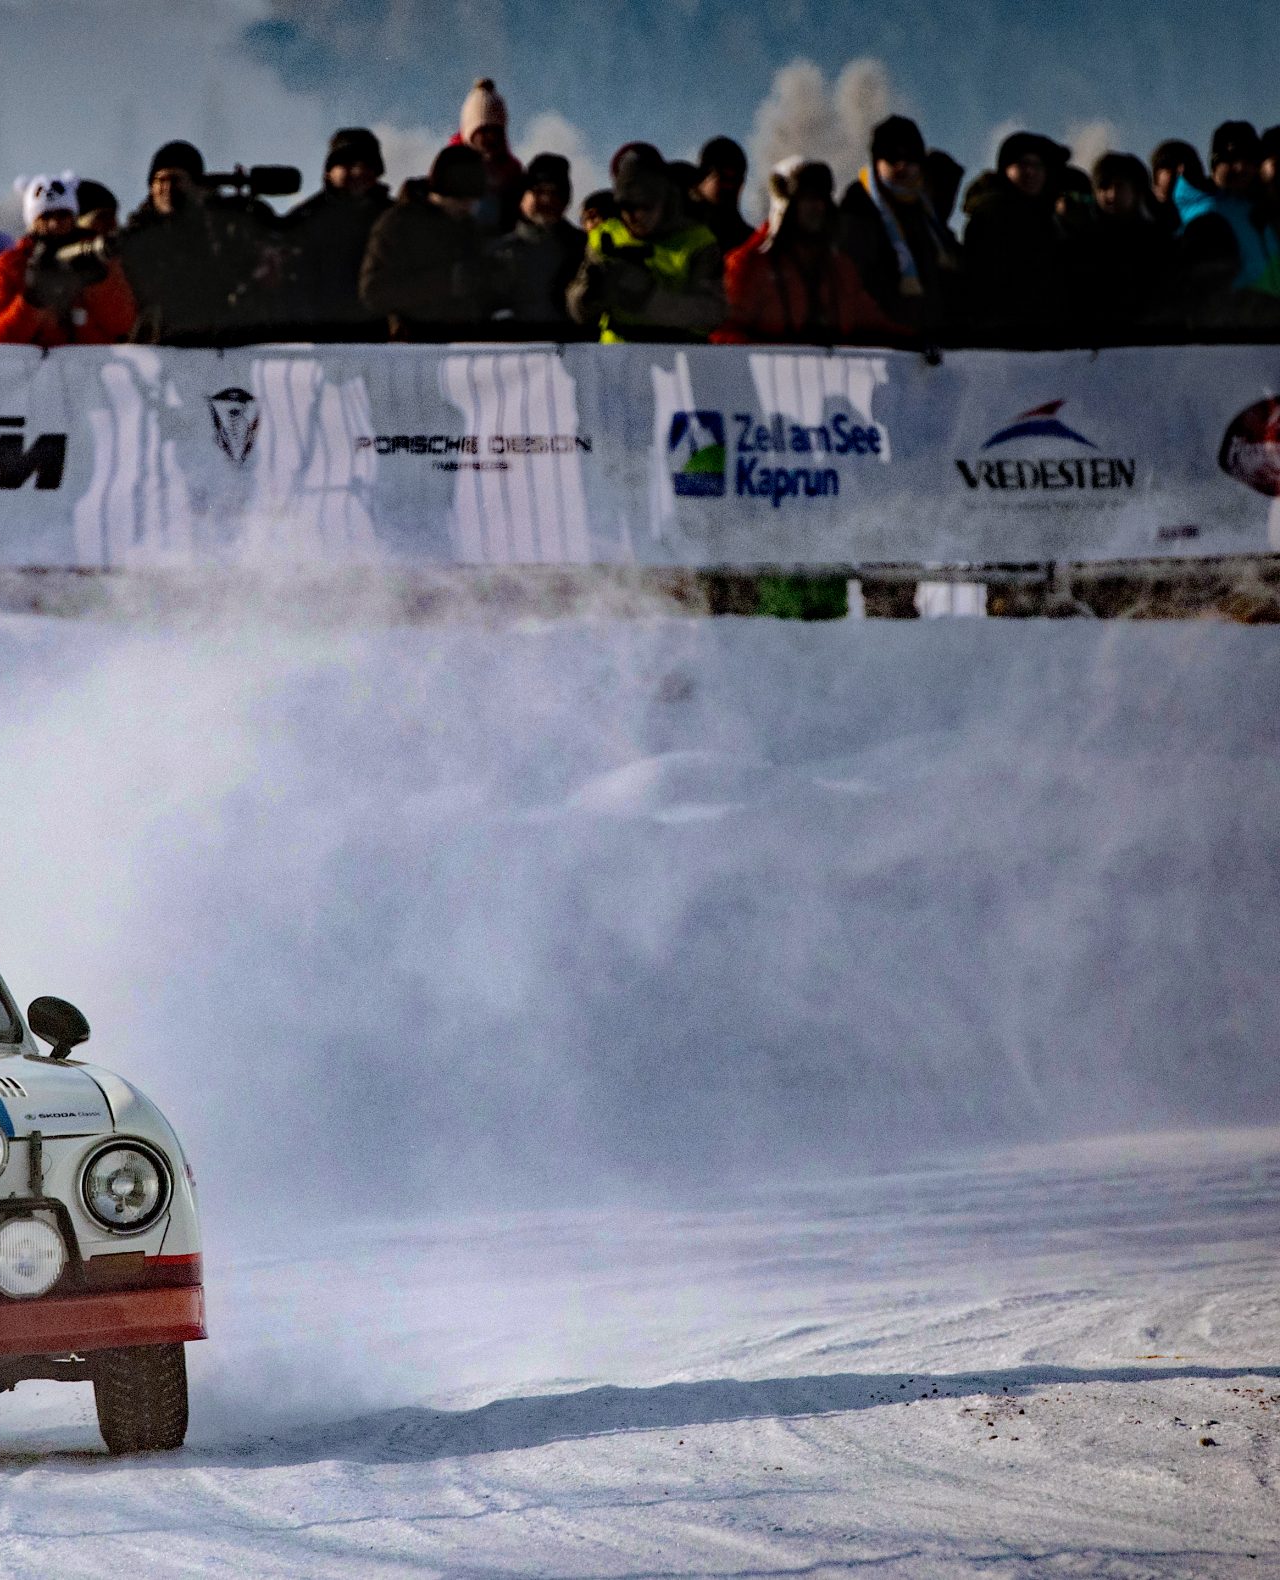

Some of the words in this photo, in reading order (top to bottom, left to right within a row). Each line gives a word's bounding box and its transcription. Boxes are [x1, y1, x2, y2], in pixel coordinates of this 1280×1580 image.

[832, 413, 882, 454] See
[735, 456, 840, 508] Kaprun
[954, 457, 1136, 490] VREDESTEIN
